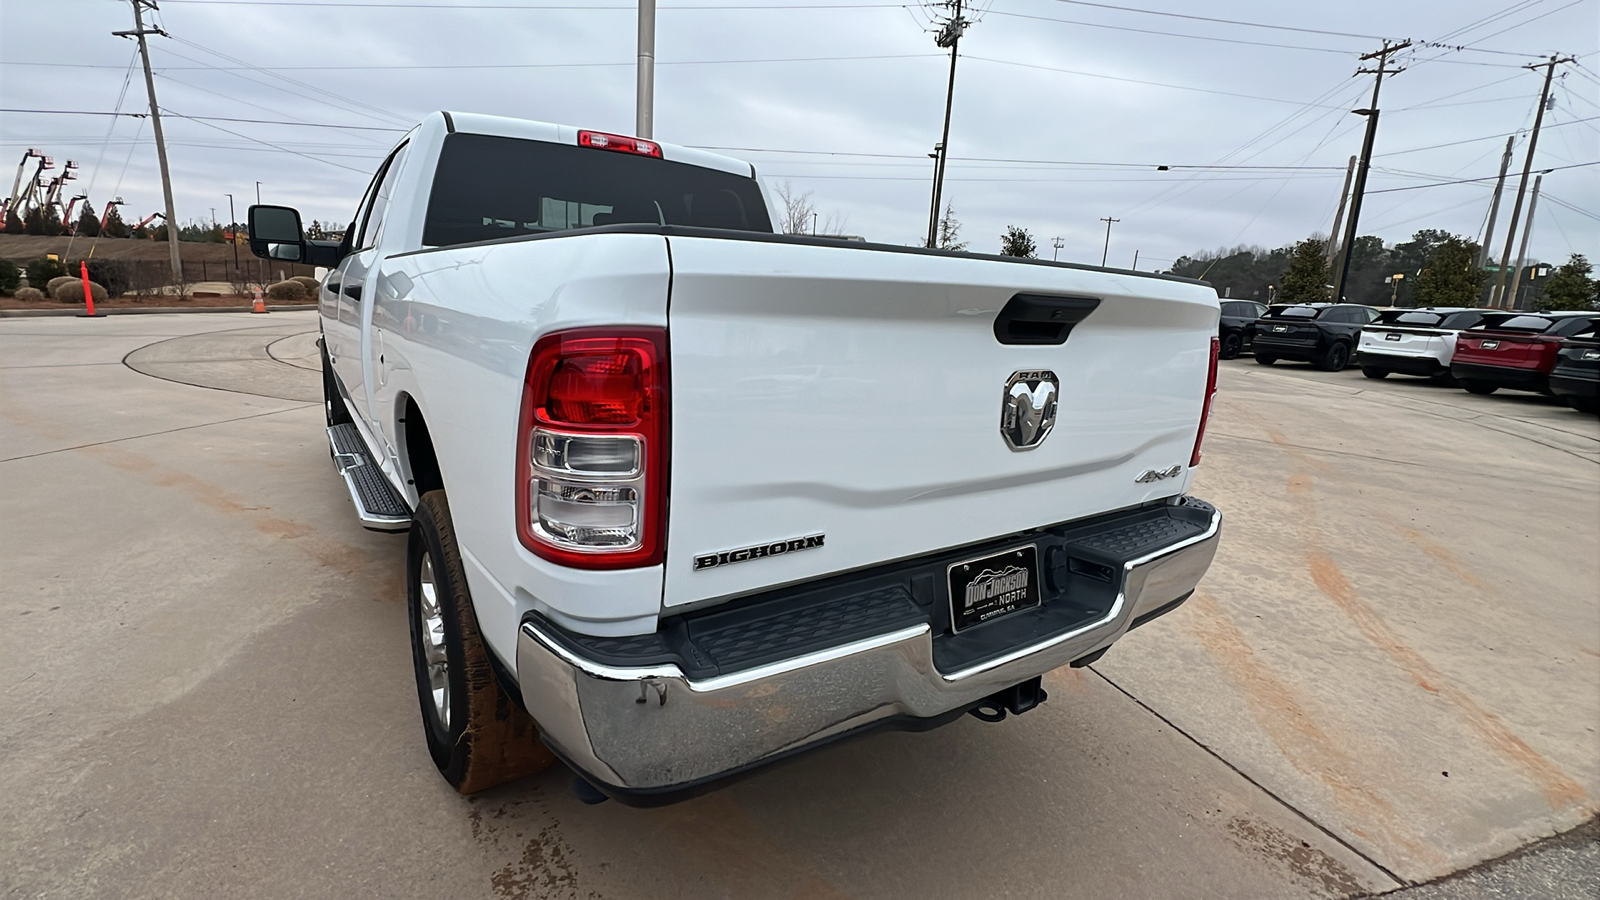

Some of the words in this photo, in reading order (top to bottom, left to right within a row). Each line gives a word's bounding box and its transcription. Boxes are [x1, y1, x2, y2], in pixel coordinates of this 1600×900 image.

[693, 533, 825, 571] BIGHORN
[965, 583, 987, 608] DON
[987, 571, 1028, 599] JACKSON
[999, 588, 1027, 605] NORTH
